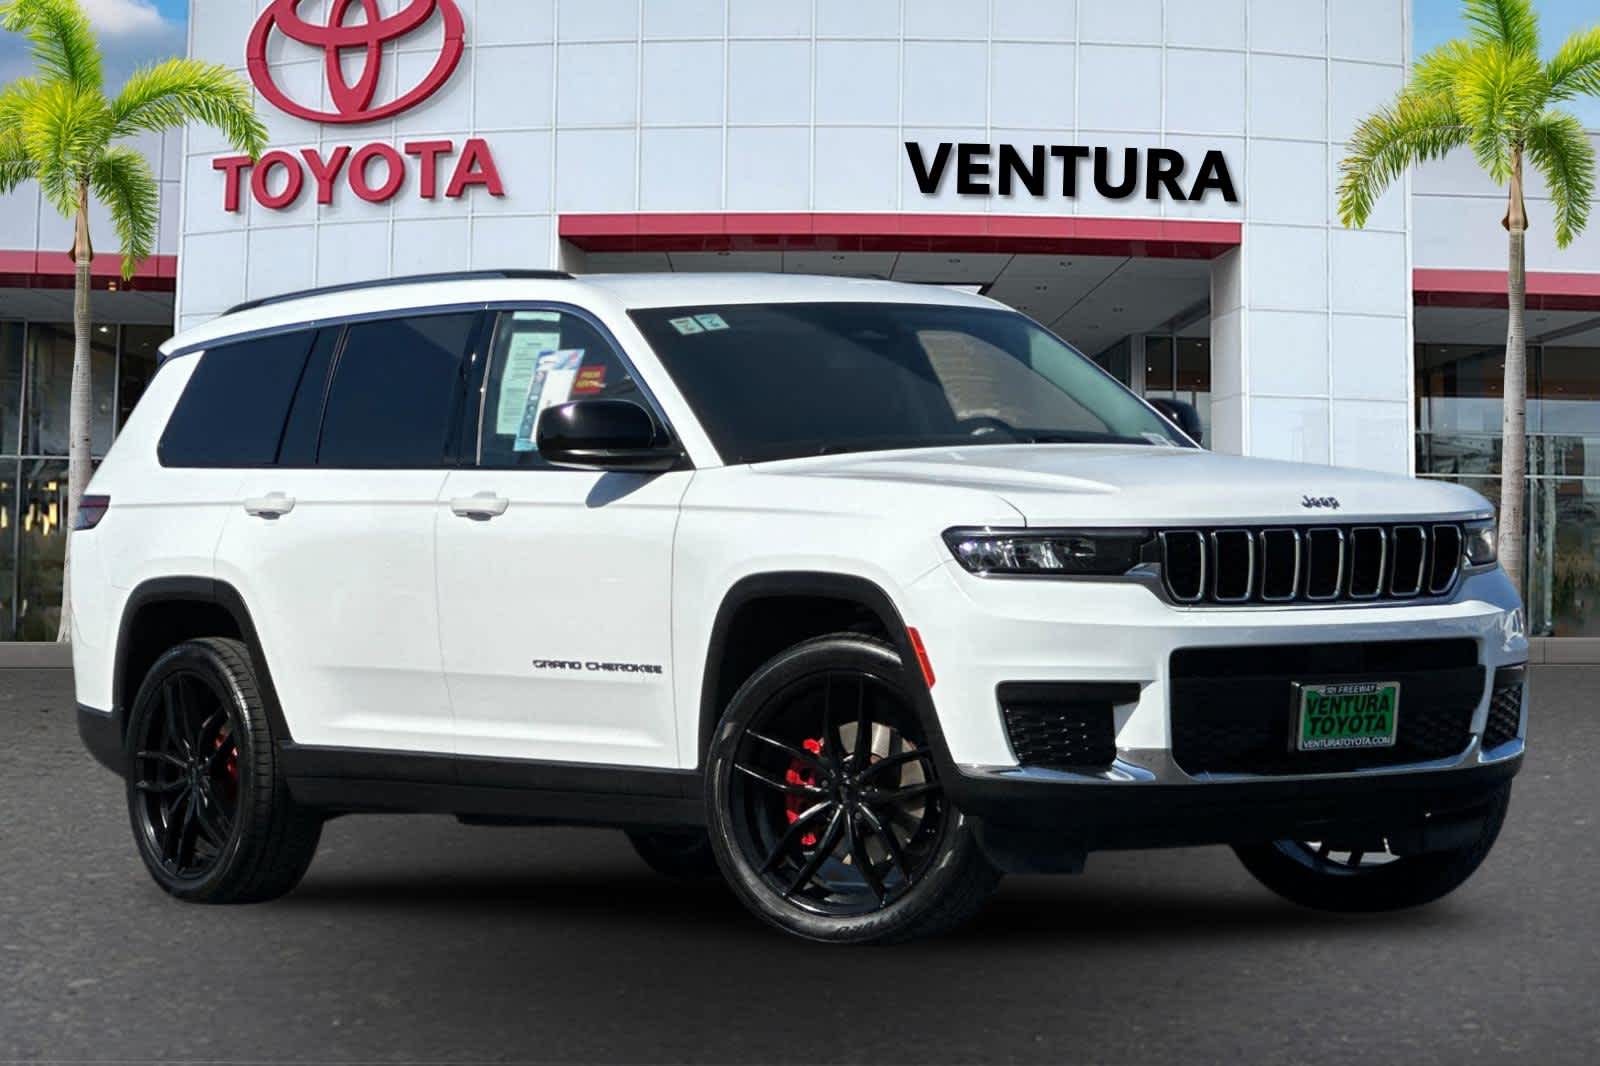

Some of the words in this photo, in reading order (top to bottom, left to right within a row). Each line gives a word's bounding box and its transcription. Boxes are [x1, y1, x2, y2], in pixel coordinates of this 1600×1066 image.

[213, 139, 505, 212] TOYOTA
[905, 142, 1238, 203] VENTURA
[1302, 495, 1340, 510] Jeep
[533, 659, 582, 670] GRAND
[585, 661, 663, 674] CHEROKEE
[1337, 684, 1377, 694] FREEWAY
[1307, 695, 1389, 715] VENTURA
[1310, 715, 1386, 736] TOYOTA
[1303, 736, 1391, 749] VENTURATOYOTA.COM
